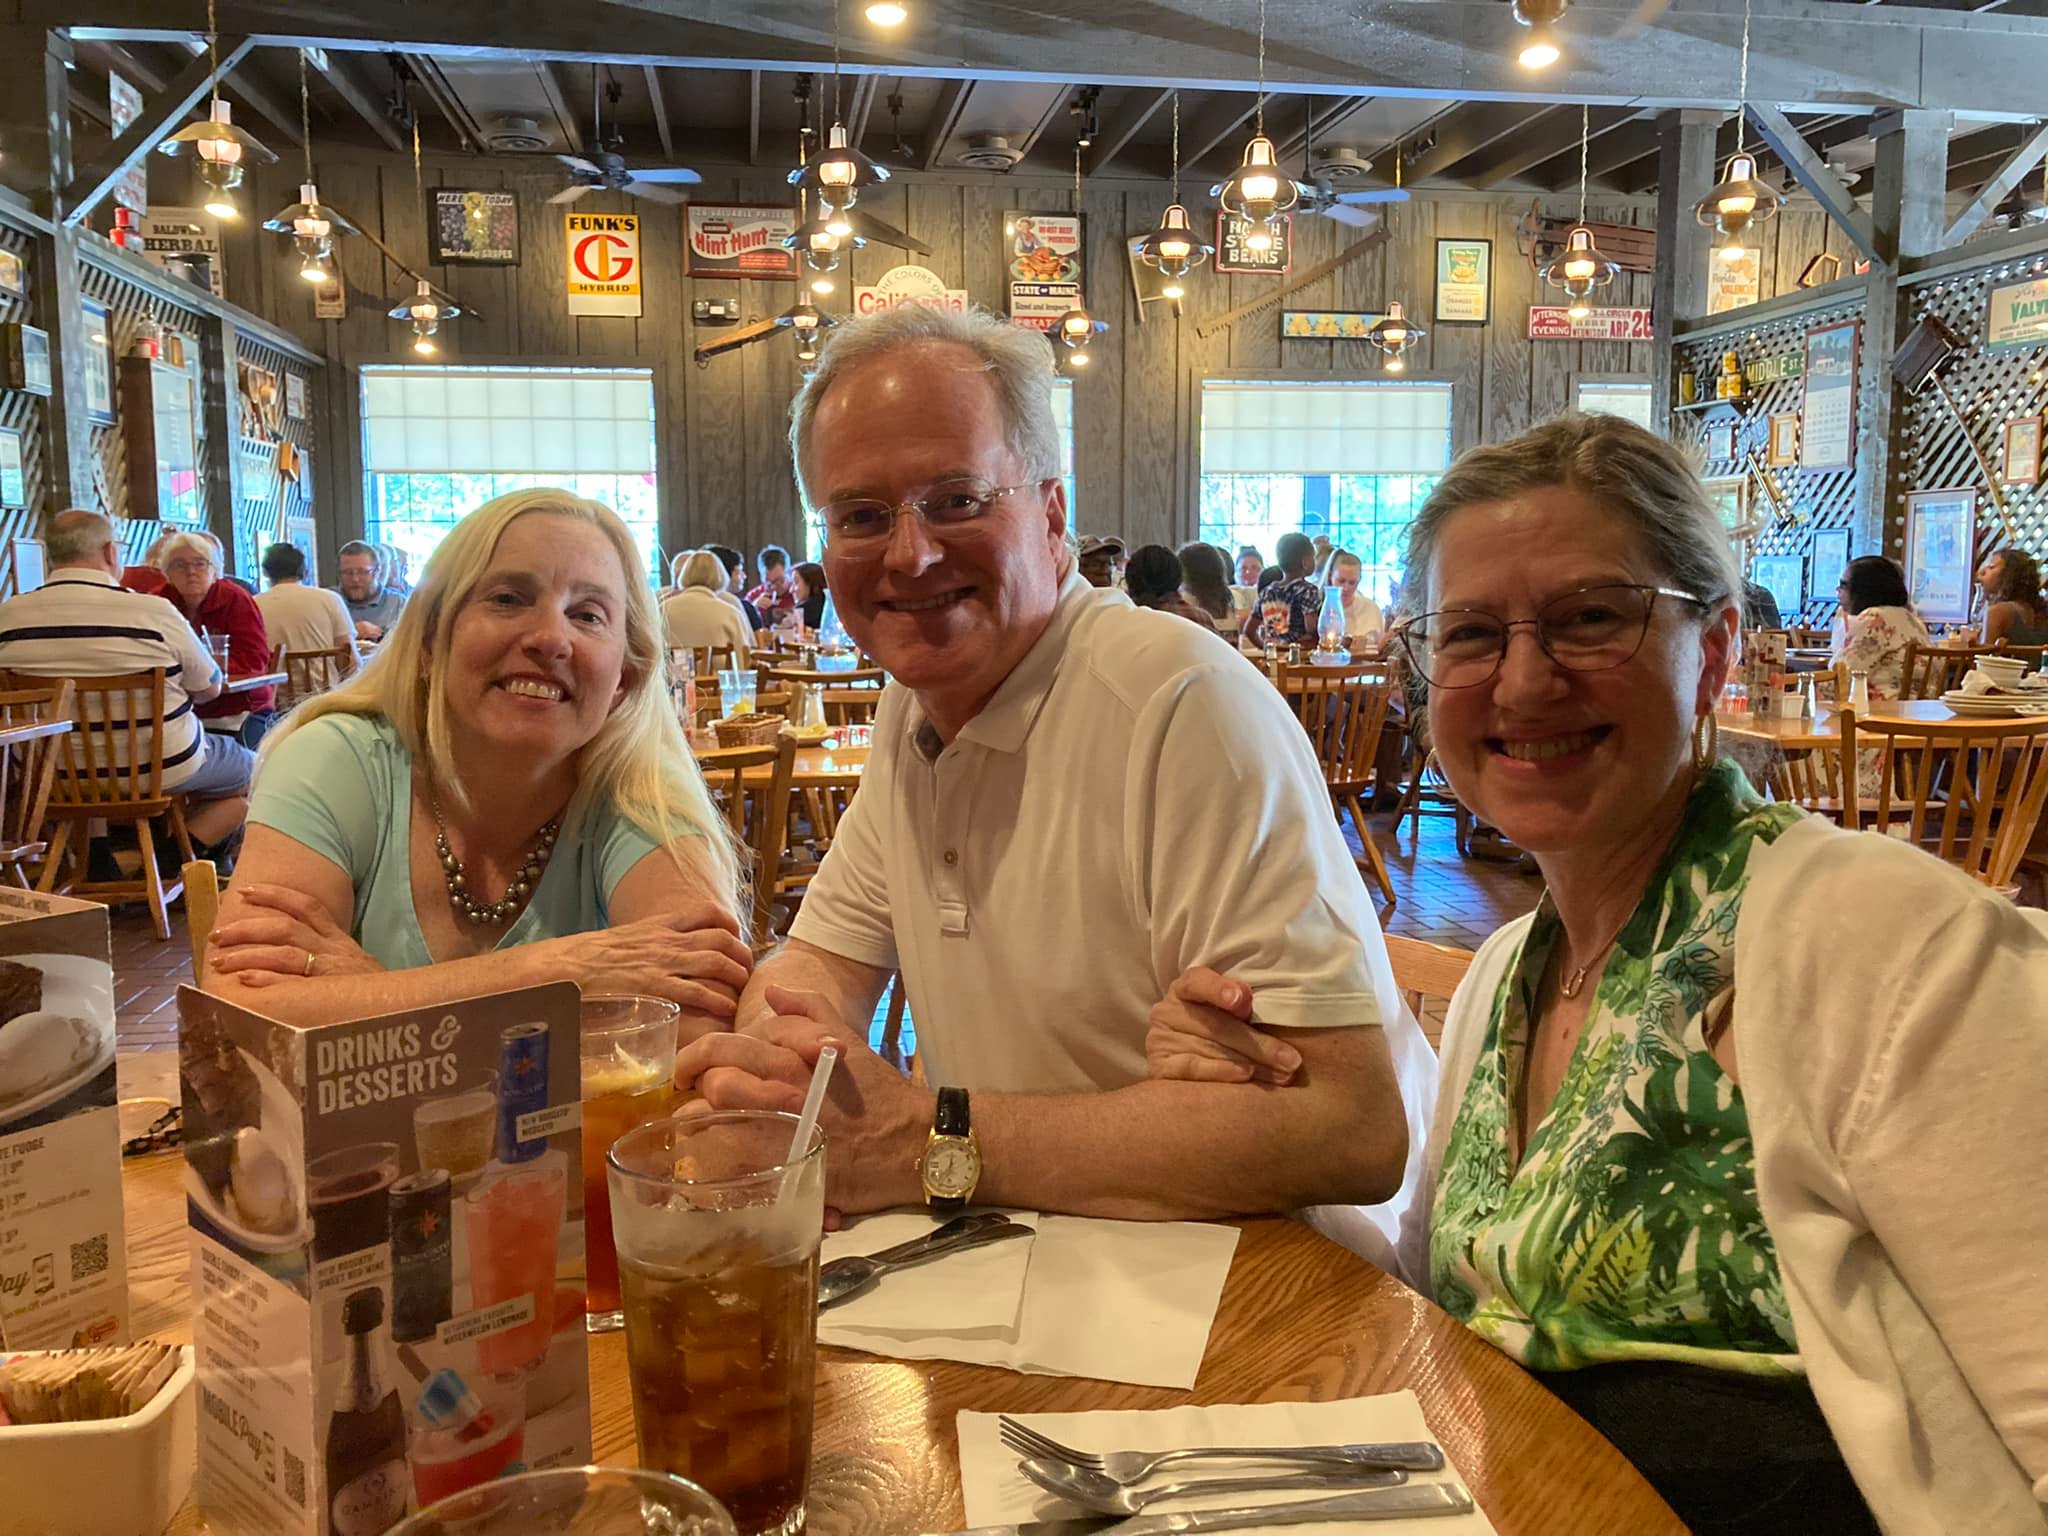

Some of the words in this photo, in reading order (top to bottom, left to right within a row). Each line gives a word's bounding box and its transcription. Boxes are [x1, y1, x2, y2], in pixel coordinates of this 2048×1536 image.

[153, 223, 207, 236] BALDWS
[569, 217, 635, 231] FUNK'S
[1229, 220, 1281, 236] RAH
[143, 237, 218, 252] HERBAL
[1224, 235, 1284, 250] STE
[574, 233, 634, 282] G
[1229, 248, 1279, 264] BEANS
[895, 270, 932, 284] COLORS
[579, 284, 630, 292] HYBRID
[1014, 285, 1041, 296] STATE
[858, 292, 963, 315] Calnia
[2011, 299, 2048, 323] VALV
[1532, 310, 1570, 322] AFTERNOO
[1532, 326, 1570, 336] EVENING
[1746, 356, 1788, 383] MIDDLE
[317, 1023, 420, 1076] DRINKS
[431, 1014, 462, 1051] &
[318, 1052, 458, 1115] DESSERTS
[12, 1136, 46, 1157] FUDGE
